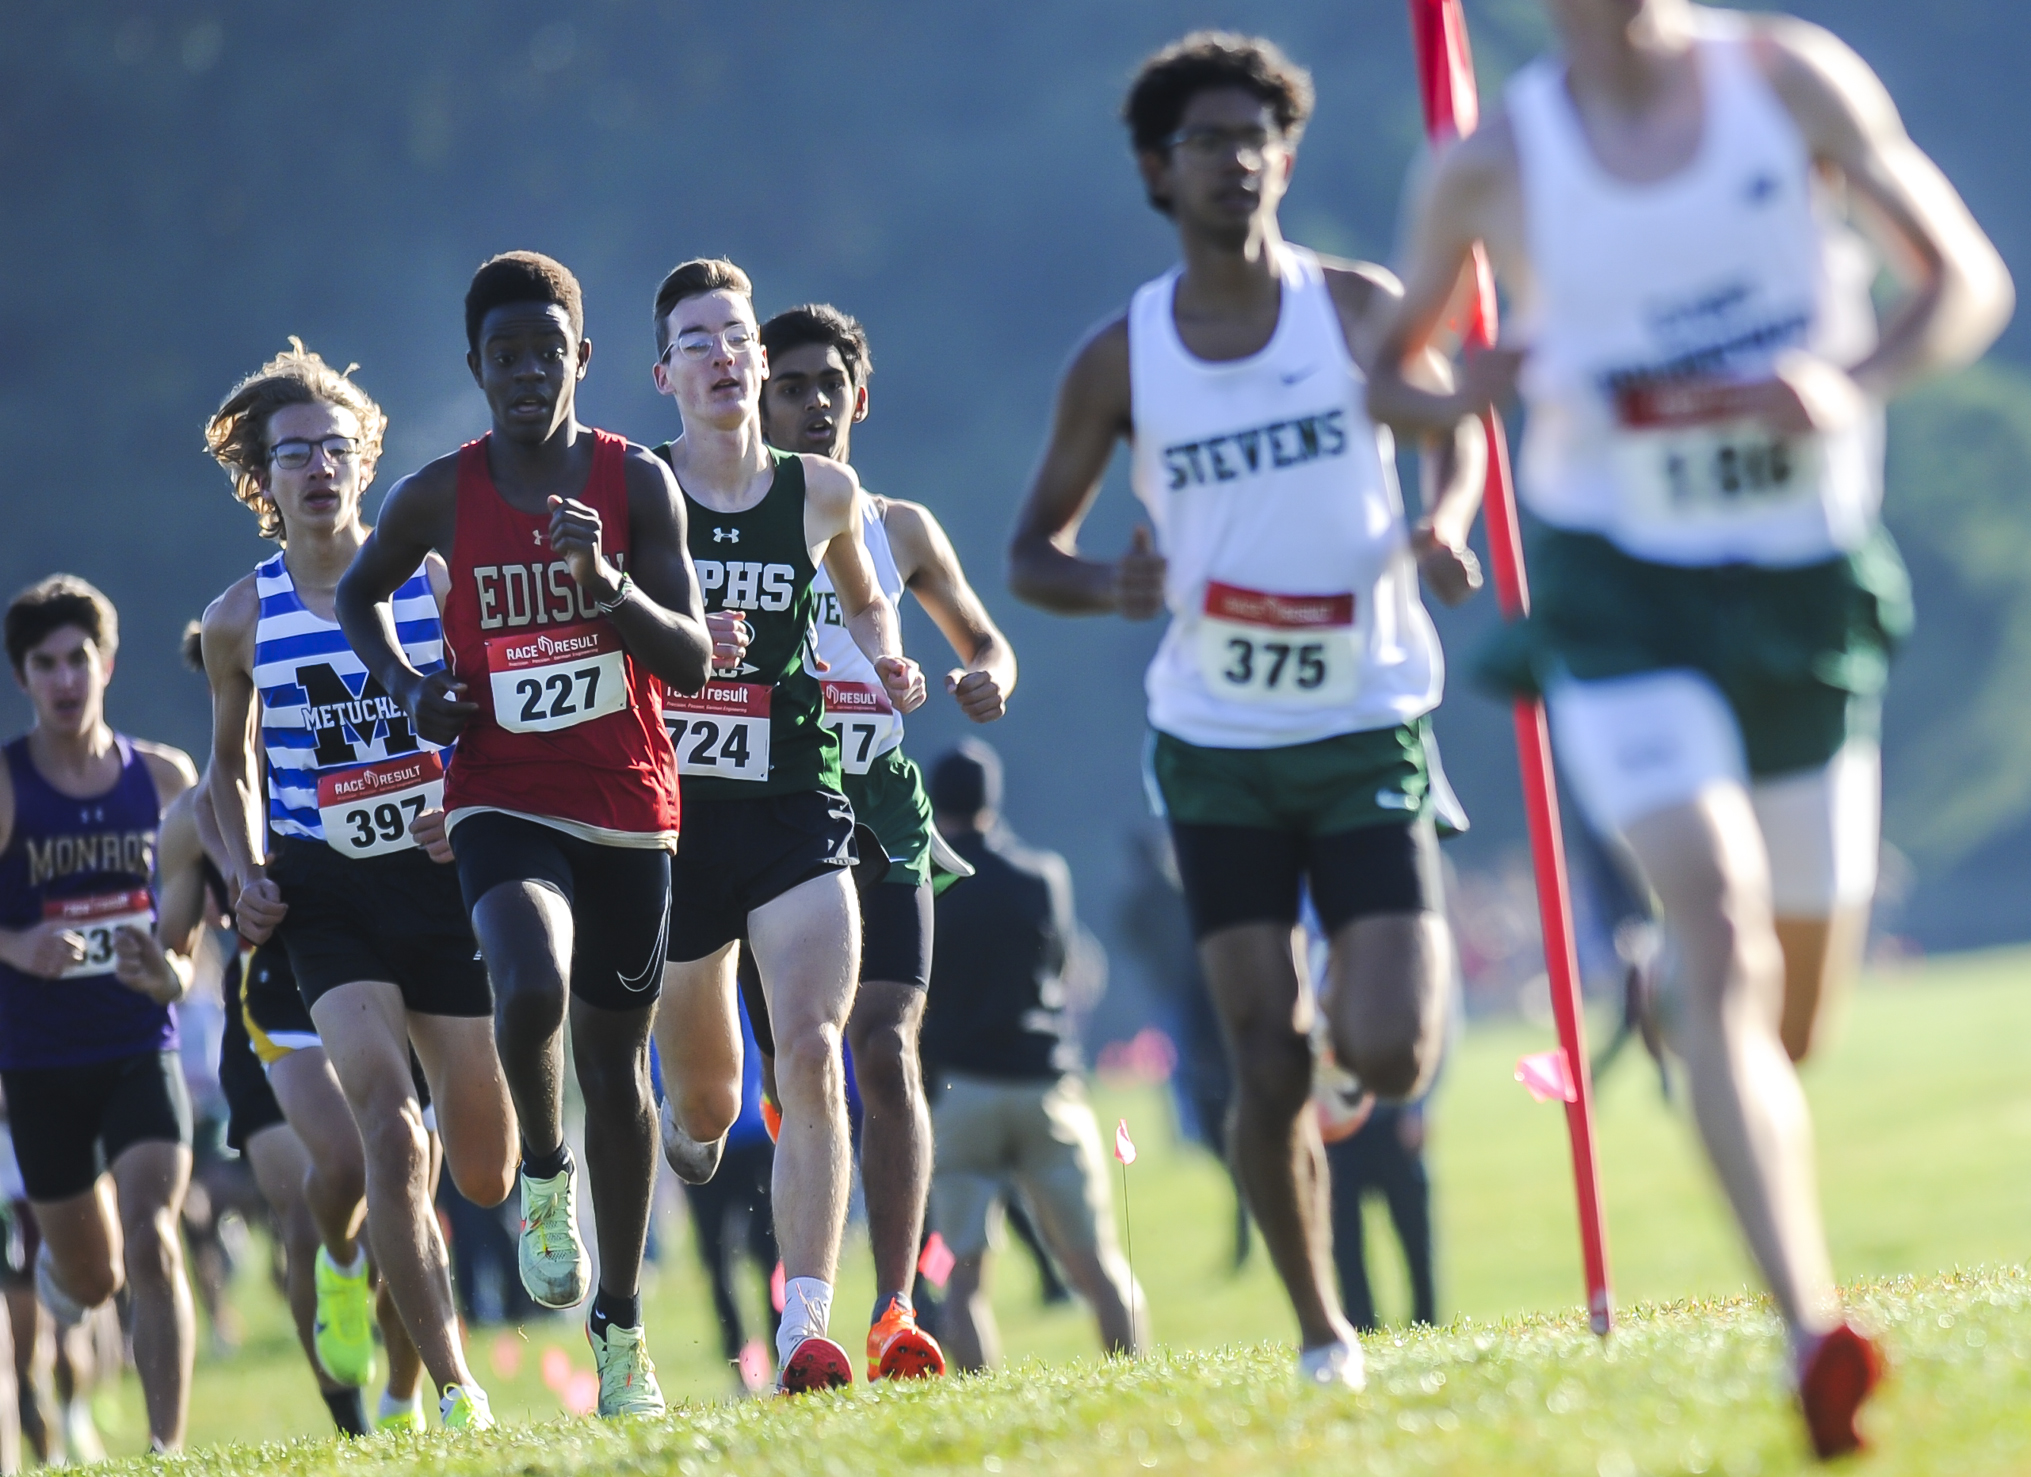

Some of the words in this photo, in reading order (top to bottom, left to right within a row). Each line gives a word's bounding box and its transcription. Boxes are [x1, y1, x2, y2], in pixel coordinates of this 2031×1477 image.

[1163, 410, 1349, 492] STEVENS
[693, 560, 795, 611] PHS
[506, 645, 539, 660] RACE
[554, 634, 599, 653] RESULT
[1225, 639, 1326, 688] 375
[301, 696, 409, 731] METUCHE
[516, 666, 601, 722] 227
[707, 687, 749, 703] result
[840, 692, 877, 705] RESULT
[663, 718, 751, 768] 724
[334, 779, 366, 795] RACE
[379, 765, 420, 786] RESULT
[346, 794, 427, 848] 397
